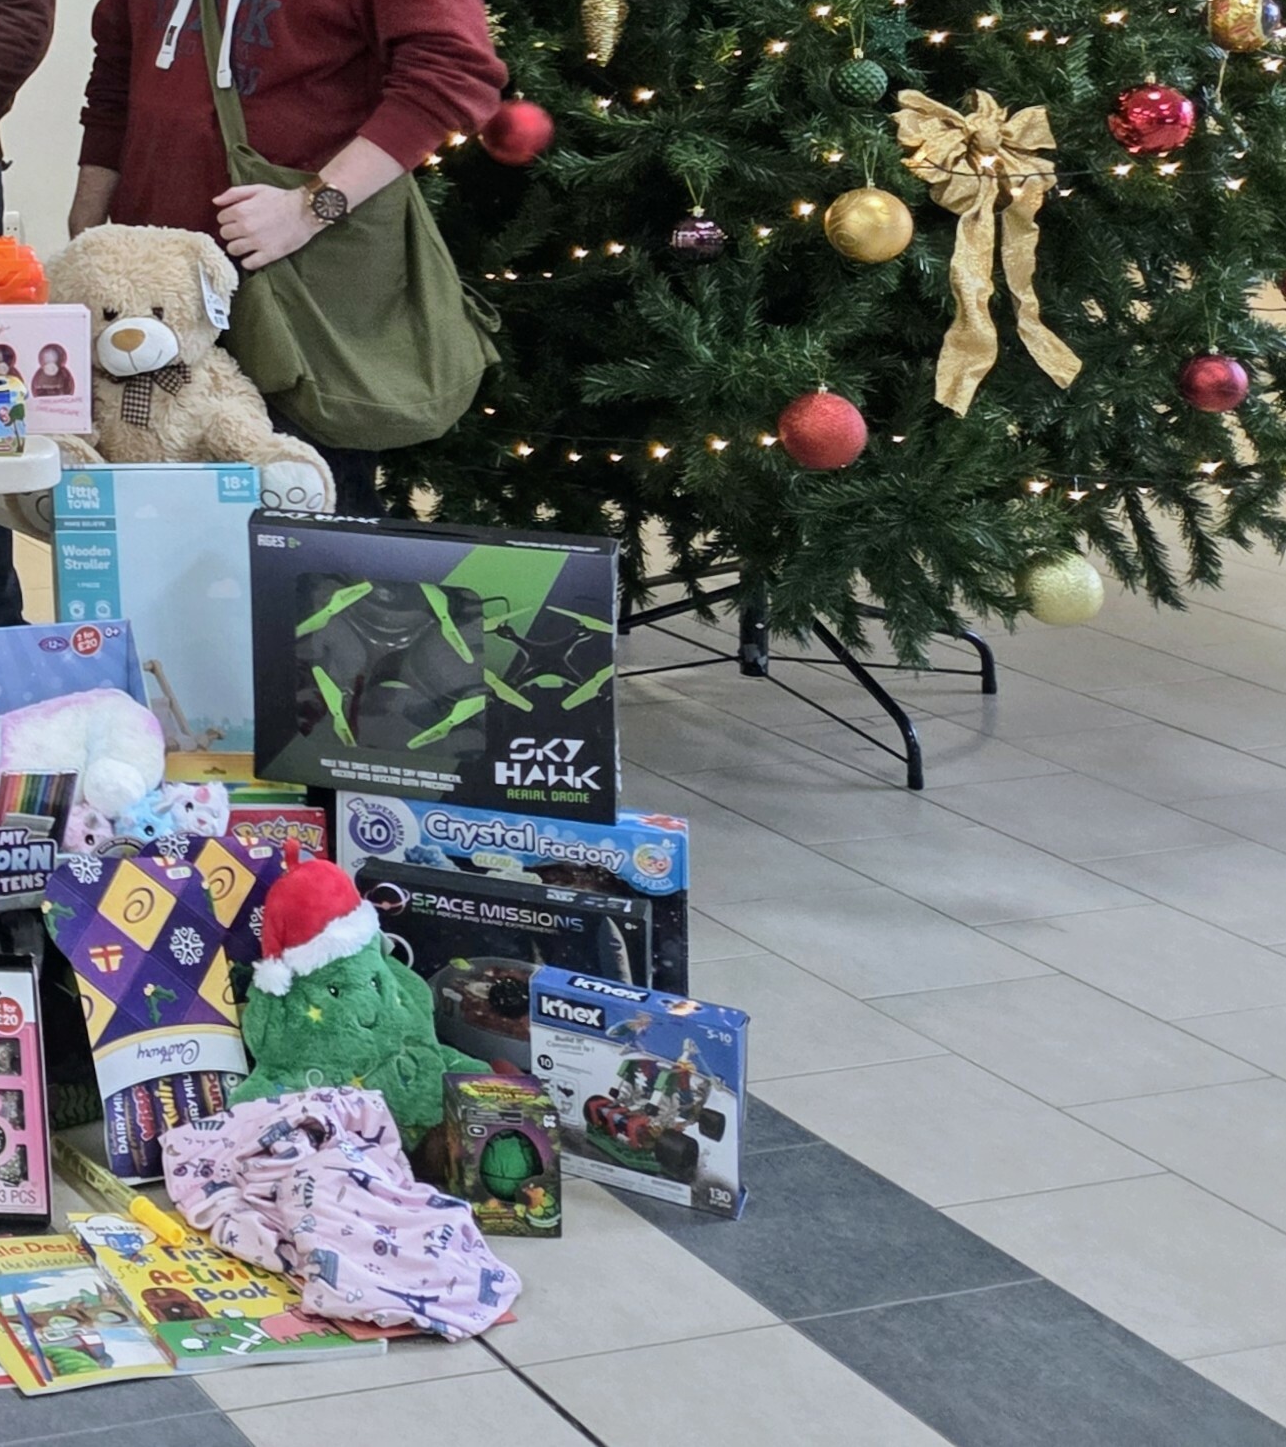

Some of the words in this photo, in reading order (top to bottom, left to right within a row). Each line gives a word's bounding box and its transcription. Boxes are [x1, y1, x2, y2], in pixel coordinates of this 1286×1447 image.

[221, 475, 250, 489] 18+
[66, 483, 100, 499] Little
[67, 496, 101, 510] TOWN
[257, 534, 286, 549] AGES
[62, 544, 111, 559] Wooden
[64, 556, 111, 571] Stroller
[509, 738, 586, 762] SKY
[494, 762, 602, 791] HAWK
[506, 789, 548, 803] AERIAL
[551, 790, 591, 803] DRONE
[364, 825, 388, 841] 10
[424, 814, 537, 854] Crystal
[539, 839, 625, 869] Factory
[410, 891, 475, 916] SPACE
[479, 901, 585, 933] MISSIONS
[707, 1029, 733, 1044] 5-10
[137, 1039, 201, 1065] Cadbury
[9, 1189, 36, 1204] PCS
[709, 1187, 732, 1202] 130
[192, 1281, 278, 1302] Book
